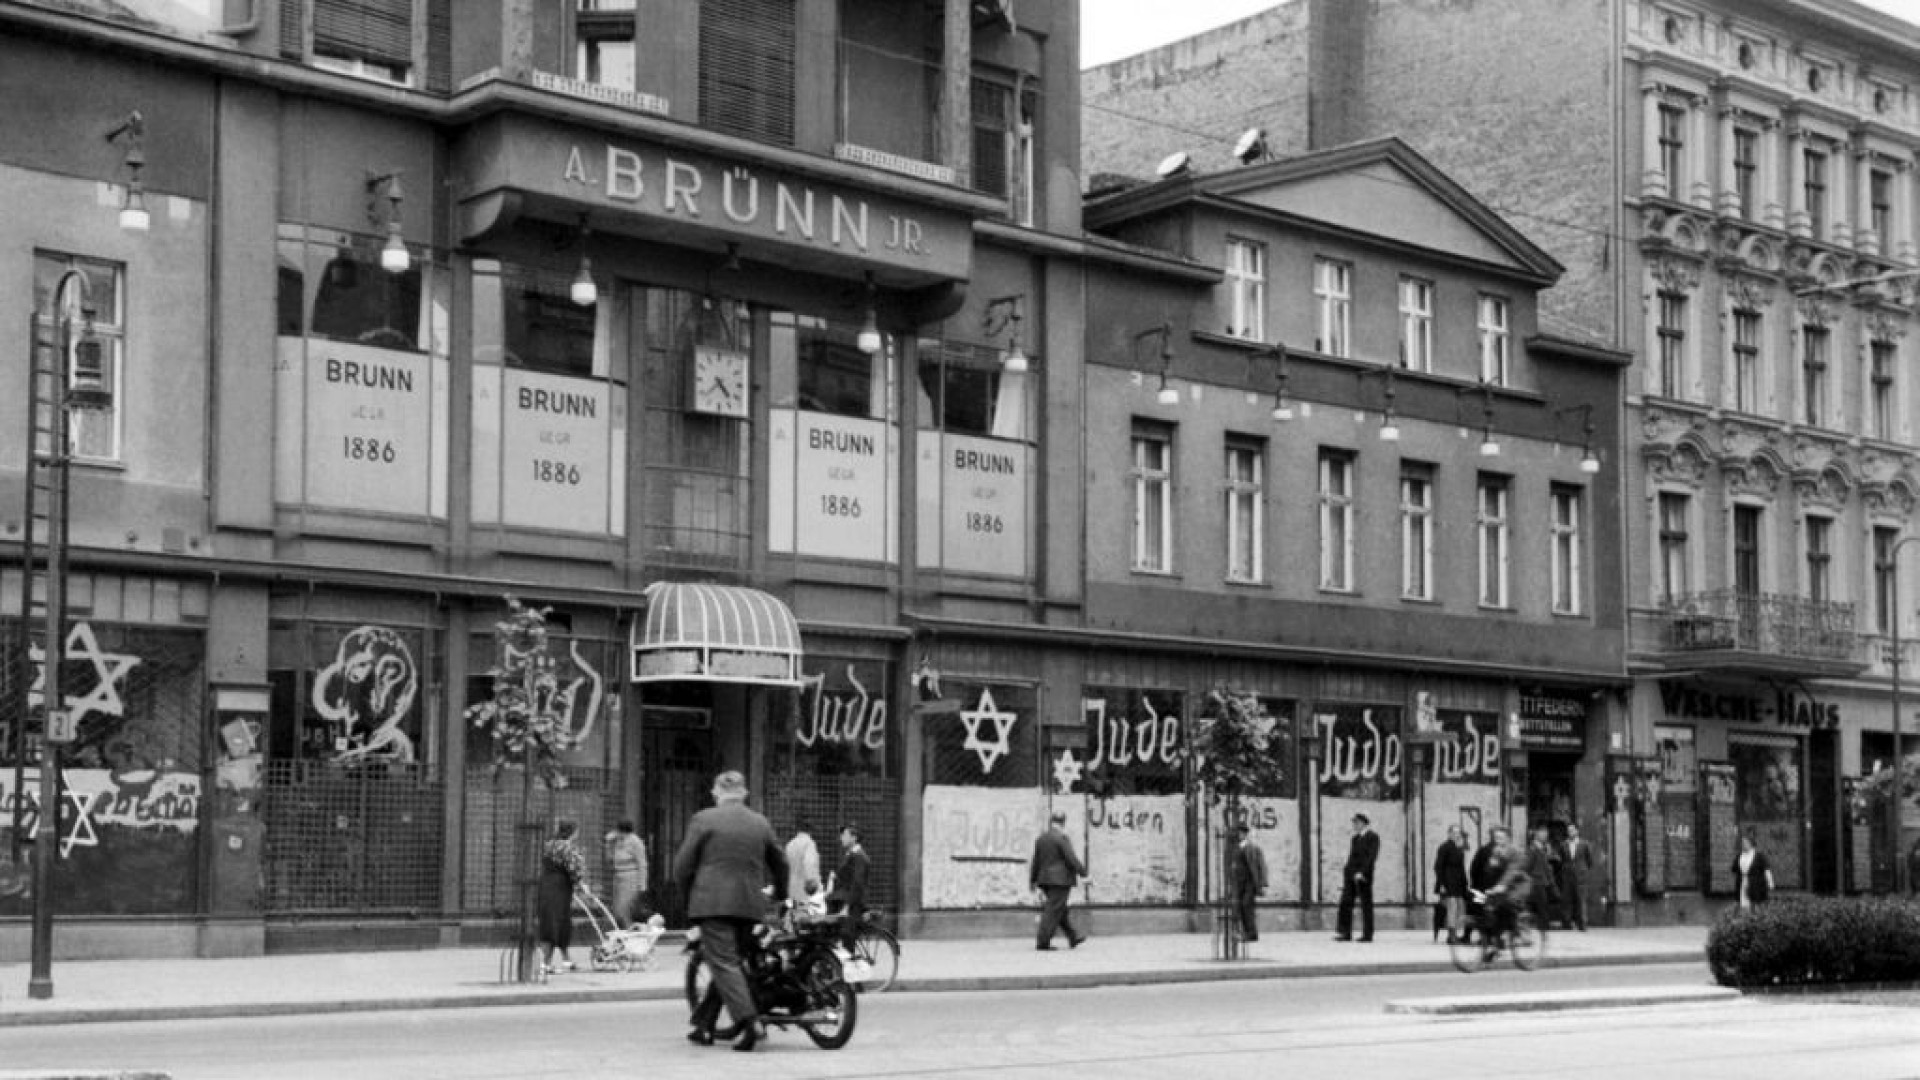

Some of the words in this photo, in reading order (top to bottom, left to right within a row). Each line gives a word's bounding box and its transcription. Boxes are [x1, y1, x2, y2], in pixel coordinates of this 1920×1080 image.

[606, 144, 869, 251] BRÜNN
[326, 358, 413, 392] BRUNN
[518, 386, 596, 418] BRUNN
[344, 435, 396, 464] 1886
[809, 427, 875, 457] BRUNN
[533, 459, 581, 486] 1886
[954, 449, 1016, 476] BRUNN
[820, 494, 862, 519] 1886
[966, 511, 1004, 535] 1886
[796, 663, 887, 749] Jude
[1082, 696, 1178, 771] Jude
[1313, 708, 1402, 787] Jude
[1087, 796, 1163, 834] Juden
